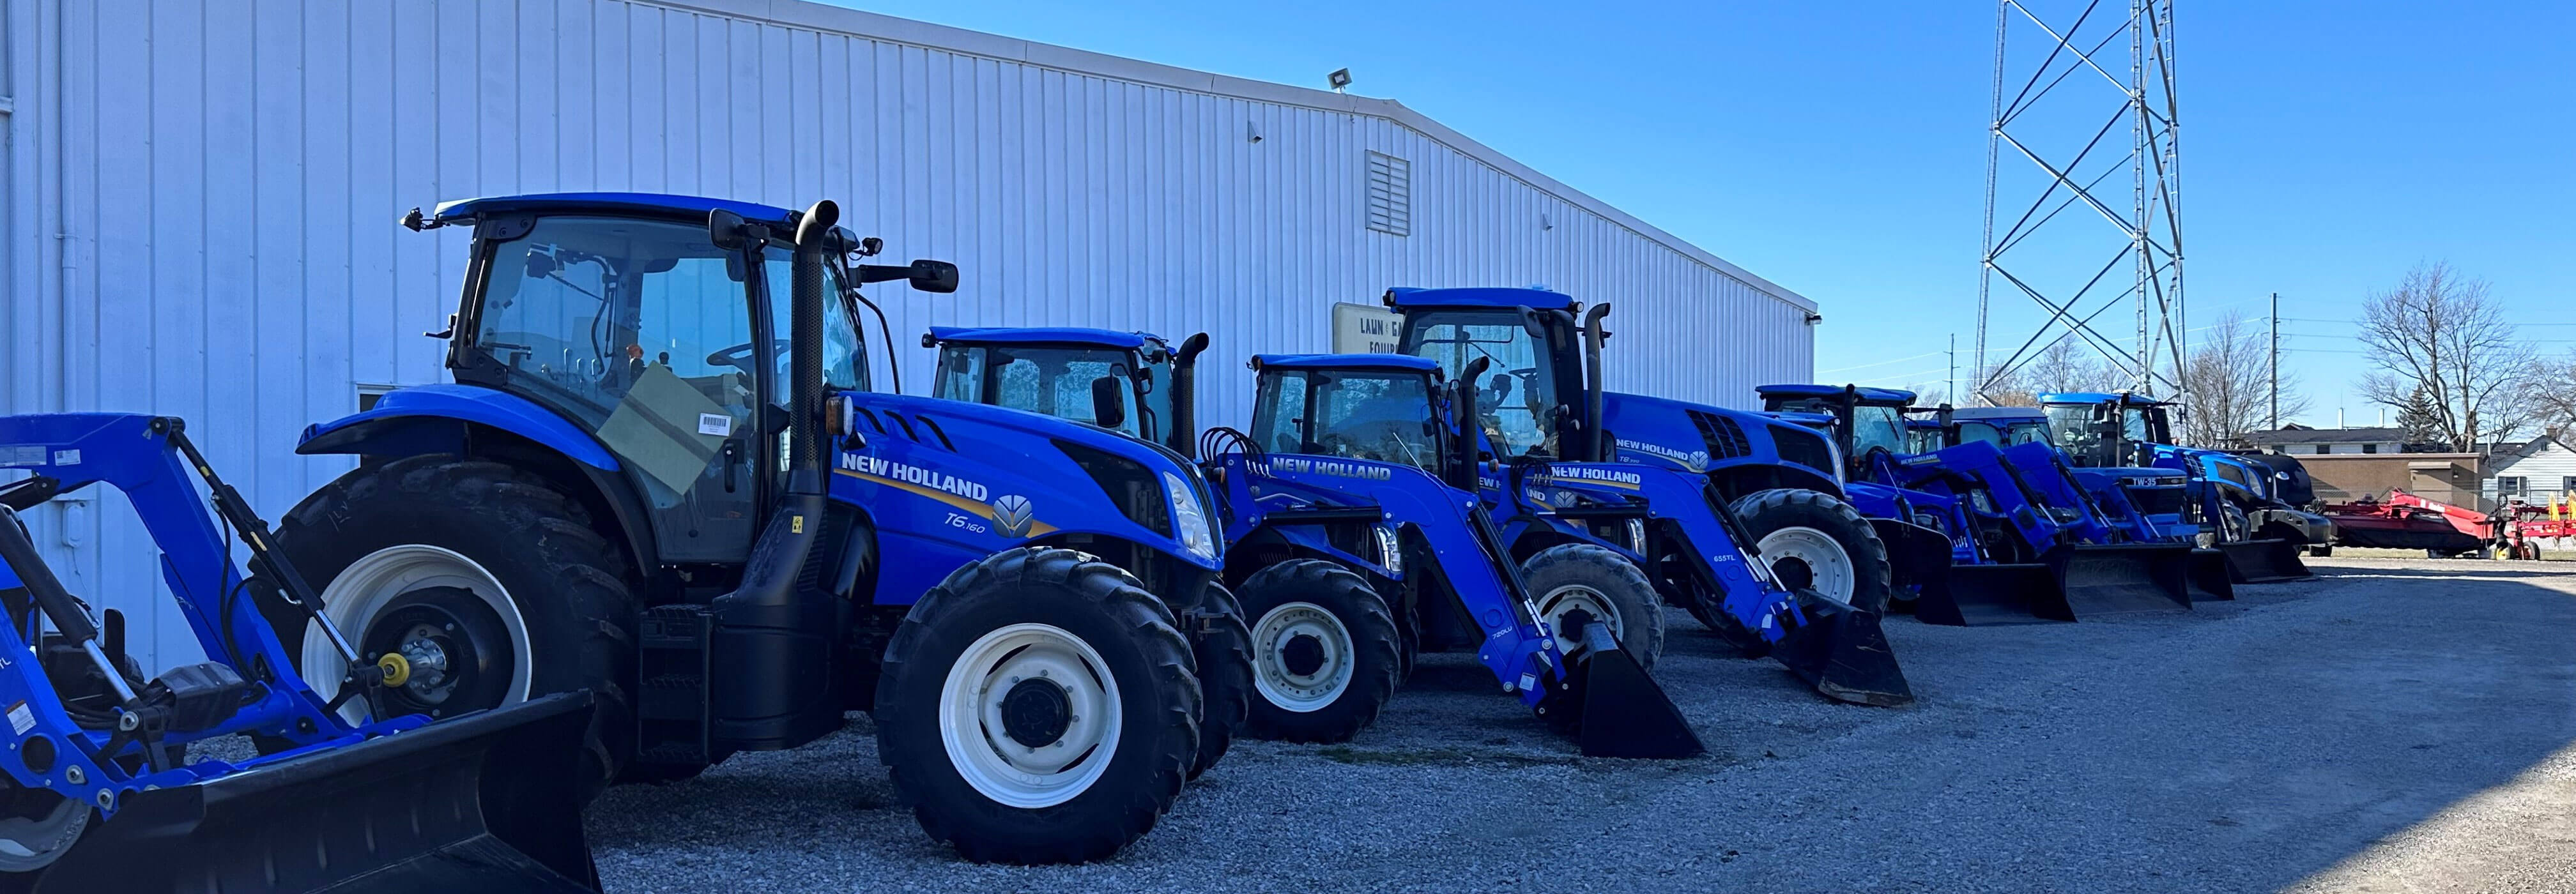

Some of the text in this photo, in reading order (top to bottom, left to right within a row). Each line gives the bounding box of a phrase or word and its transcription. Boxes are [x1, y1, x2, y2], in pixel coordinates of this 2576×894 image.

[1360, 317, 1384, 336] LAWN
[1616, 439, 1689, 460] NEW HOLLAND
[841, 452, 988, 502] NEW HOLLAND
[1272, 457, 1392, 481] NEW HOLLAND
[1551, 466, 1641, 484] NEW HOLLAND
[1479, 477, 1494, 488] EW
[944, 512, 986, 534] T6.160
